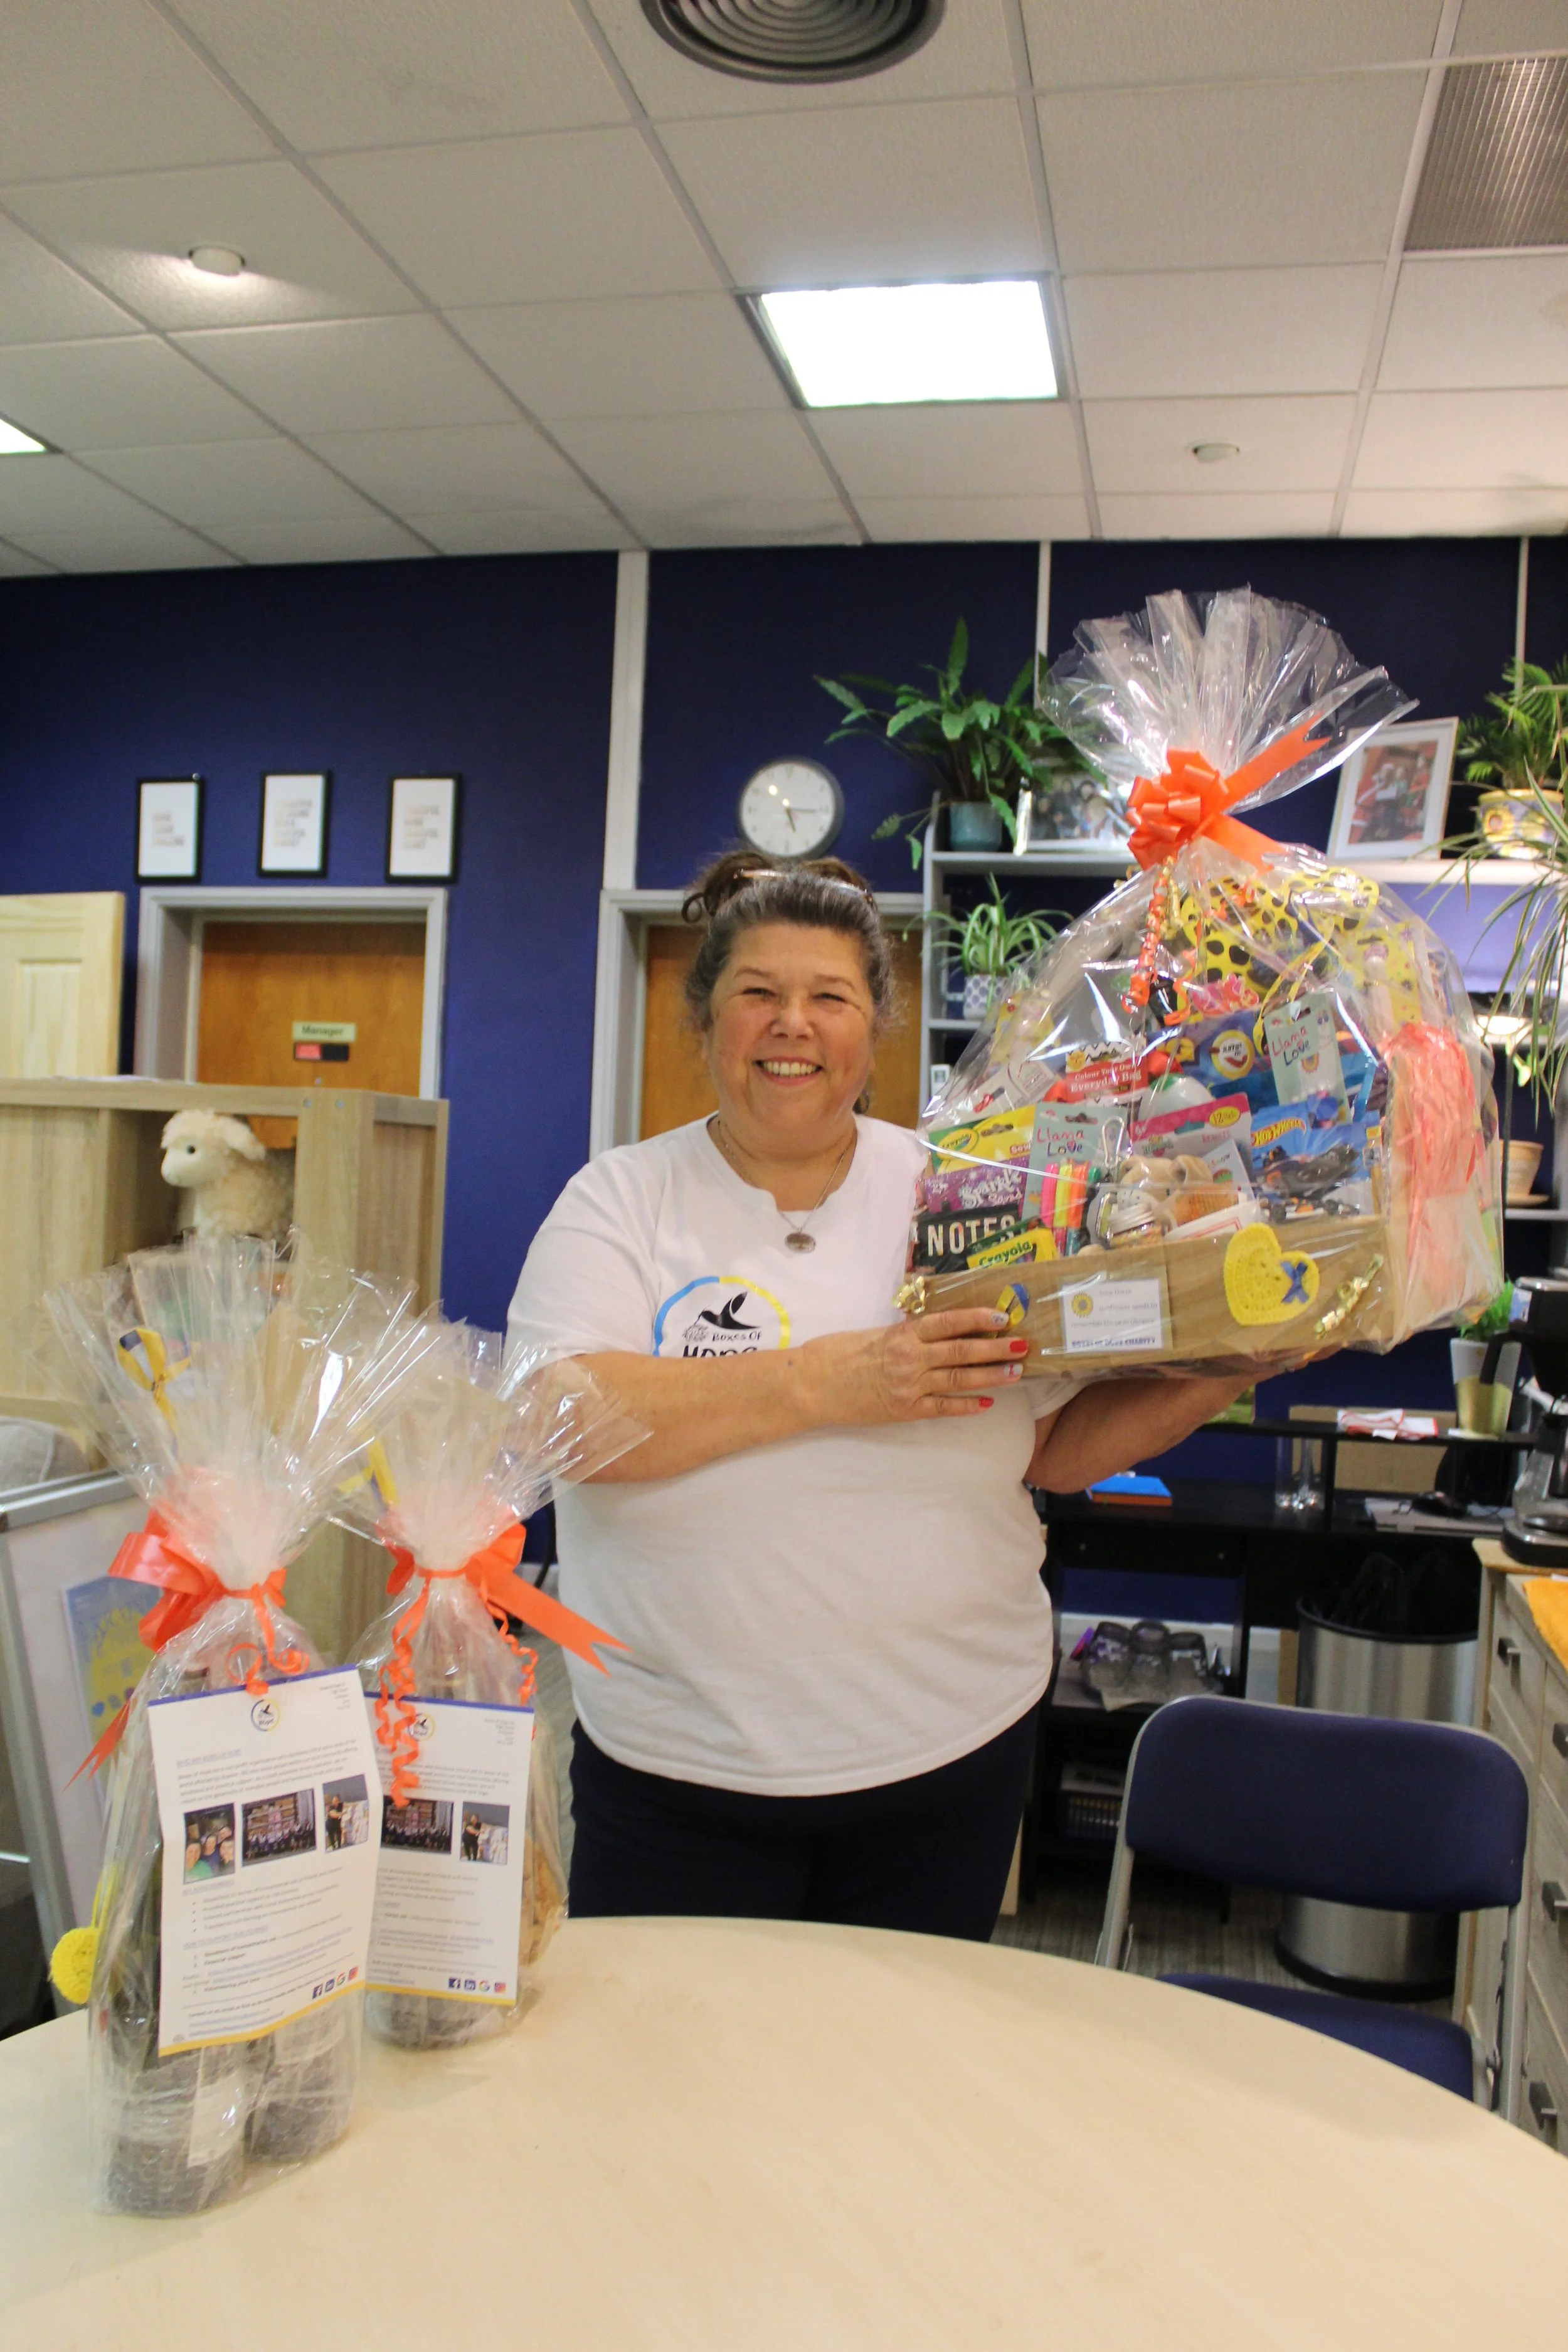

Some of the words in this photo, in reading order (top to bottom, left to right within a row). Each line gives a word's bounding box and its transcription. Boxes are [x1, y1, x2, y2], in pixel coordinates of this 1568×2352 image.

[302, 1024, 343, 1037] Manager
[1271, 1025, 1308, 1057] Llama
[1284, 1039, 1310, 1066] Love
[1075, 1070, 1100, 1082] Colour
[1037, 1126, 1084, 1143] Llama
[1254, 1128, 1273, 1148] HOT
[1047, 1141, 1083, 1157] Love
[978, 1241, 1033, 1269] Crayola
[712, 1333, 746, 1342] Boxes
